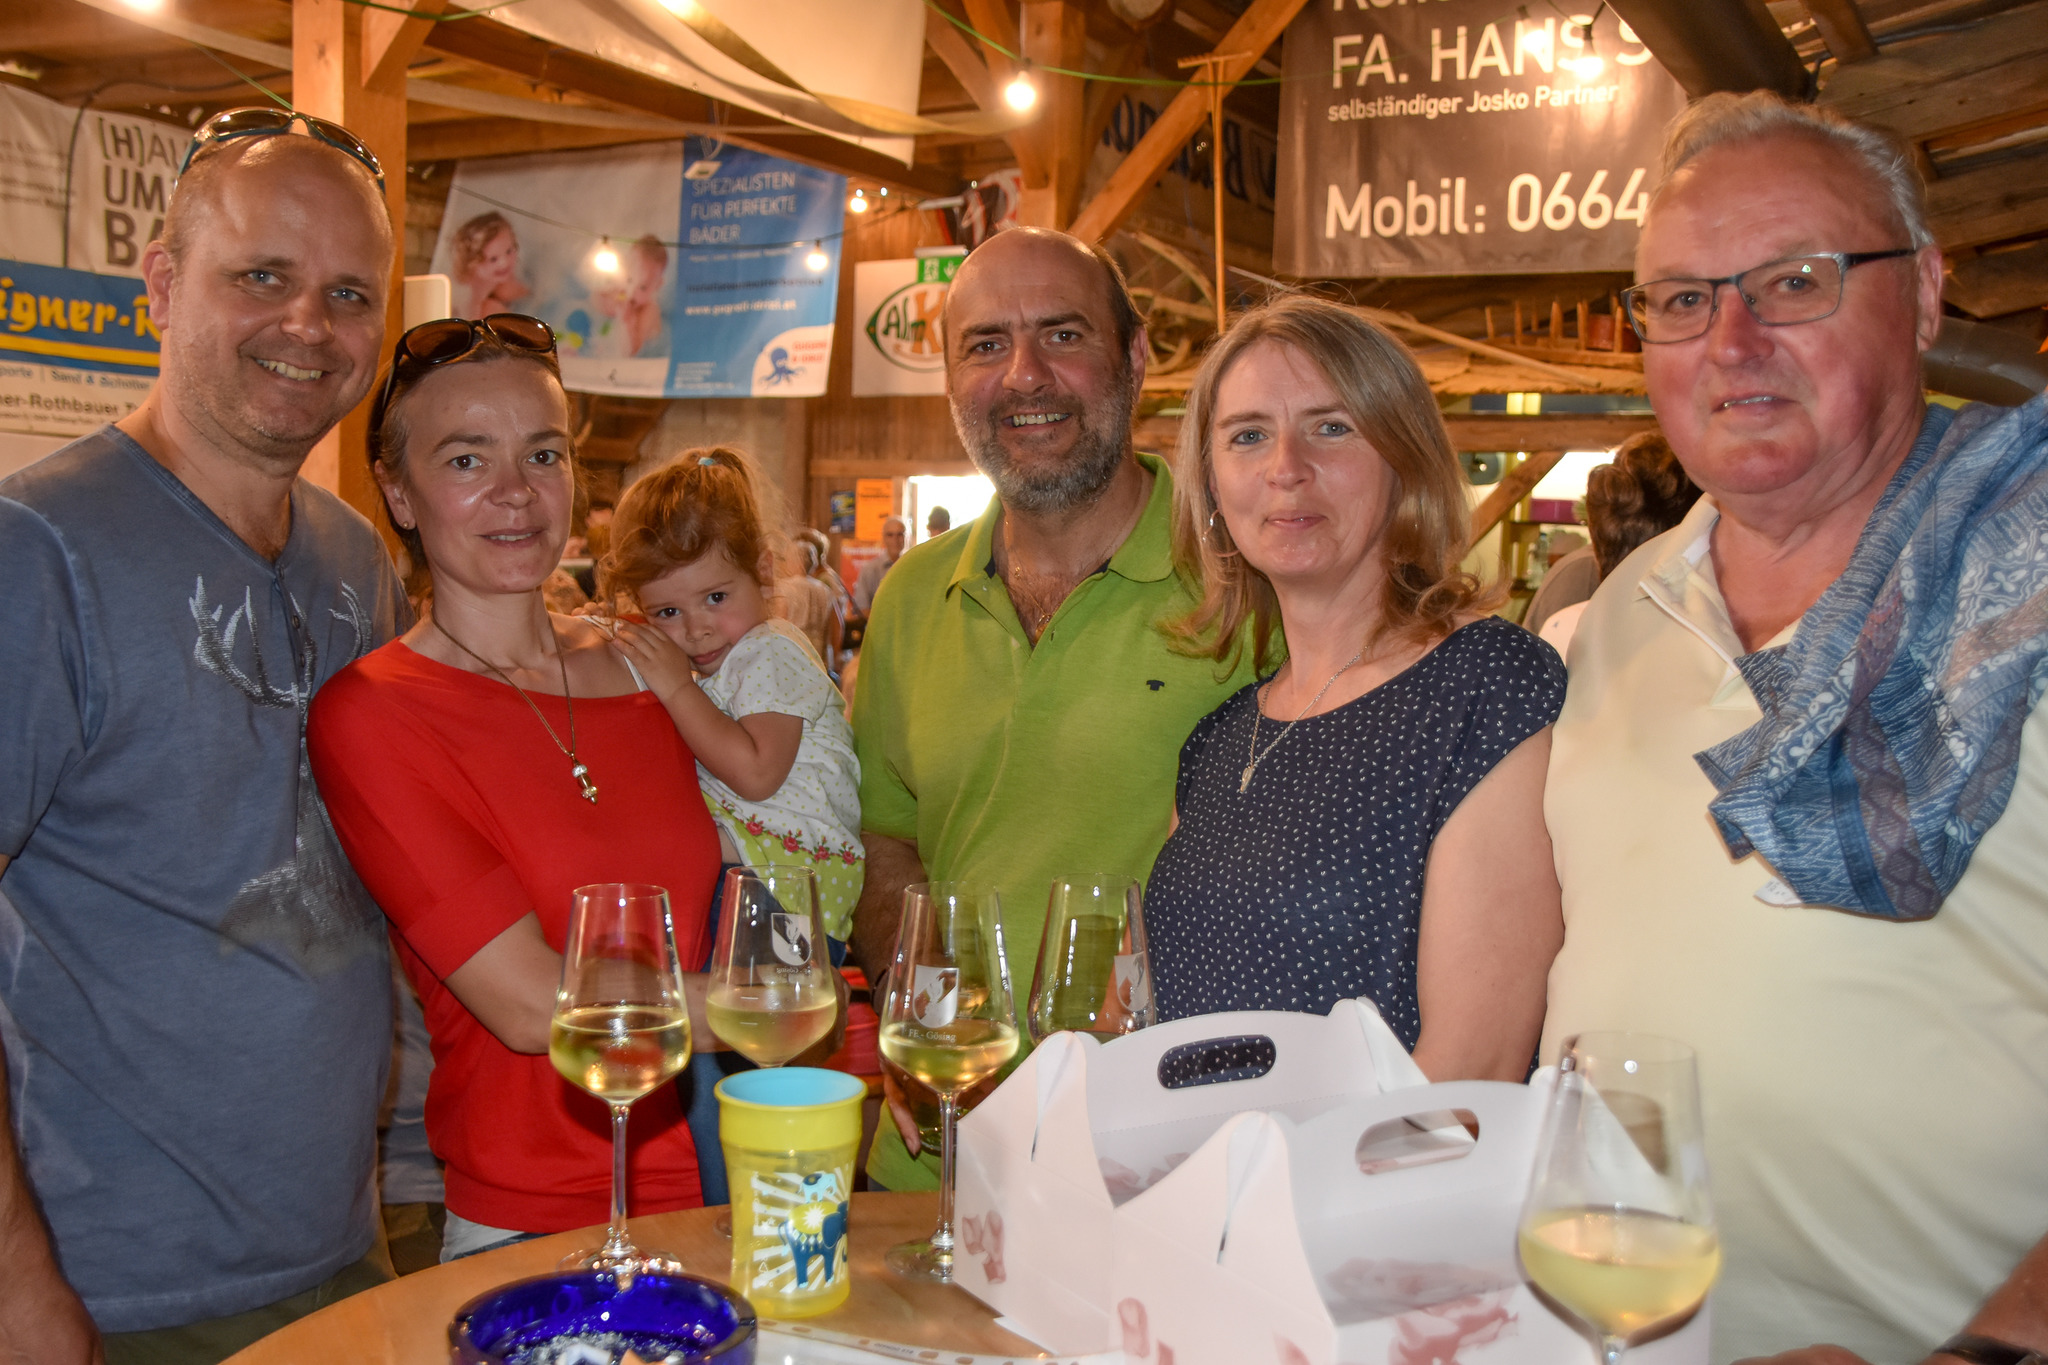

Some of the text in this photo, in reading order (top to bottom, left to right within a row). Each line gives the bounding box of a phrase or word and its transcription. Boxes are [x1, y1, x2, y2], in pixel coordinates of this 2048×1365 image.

[1333, 33, 1408, 89] FA.
[1431, 15, 1596, 82] HANS
[1328, 83, 1619, 121] selbständiger Josko Partner
[104, 165, 176, 213] UM
[692, 171, 796, 197] SPEZIALISTEN
[724, 194, 798, 218] PERFEKTE
[1325, 168, 1650, 239] Mobil: 0664
[0, 392, 119, 416] er-Rothbauer
